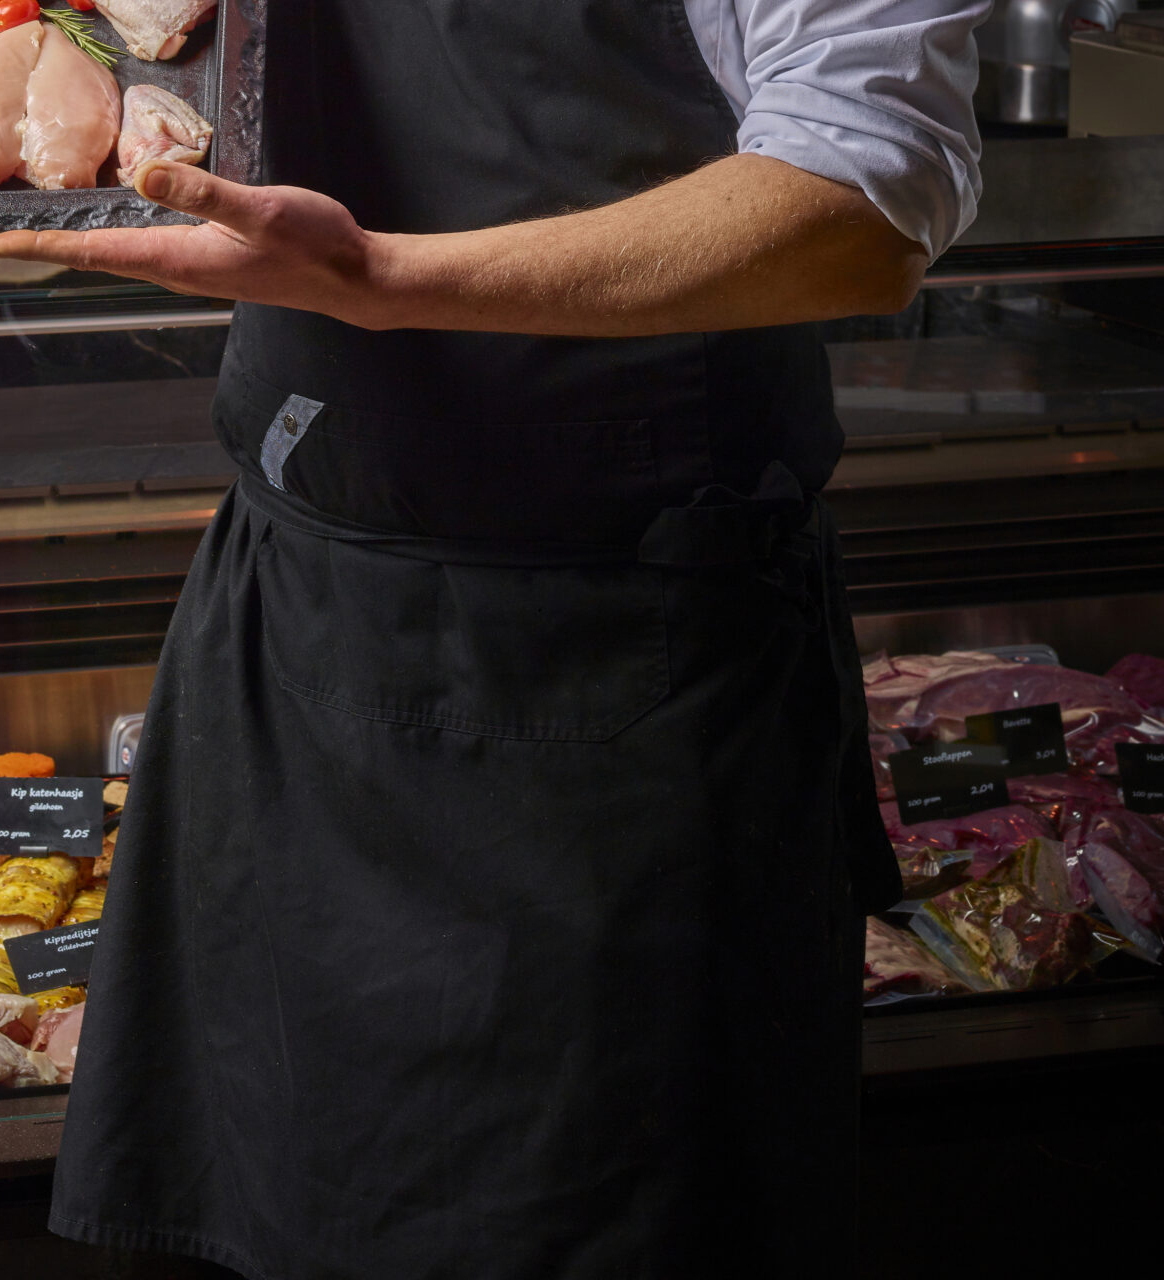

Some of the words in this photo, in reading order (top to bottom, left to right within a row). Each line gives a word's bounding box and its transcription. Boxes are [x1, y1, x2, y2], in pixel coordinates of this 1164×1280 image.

[11, 788, 27, 799] Kip
[29, 787, 84, 800] katenhaasje
[28, 802, 64, 812] gildehoen
[907, 798, 922, 807] 100
[922, 796, 942, 806] gram
[10, 831, 31, 839] gram
[62, 829, 90, 839] 2,05
[57, 940, 95, 952] Gildehoen
[27, 972, 44, 980] 100
[45, 967, 67, 978] gram
